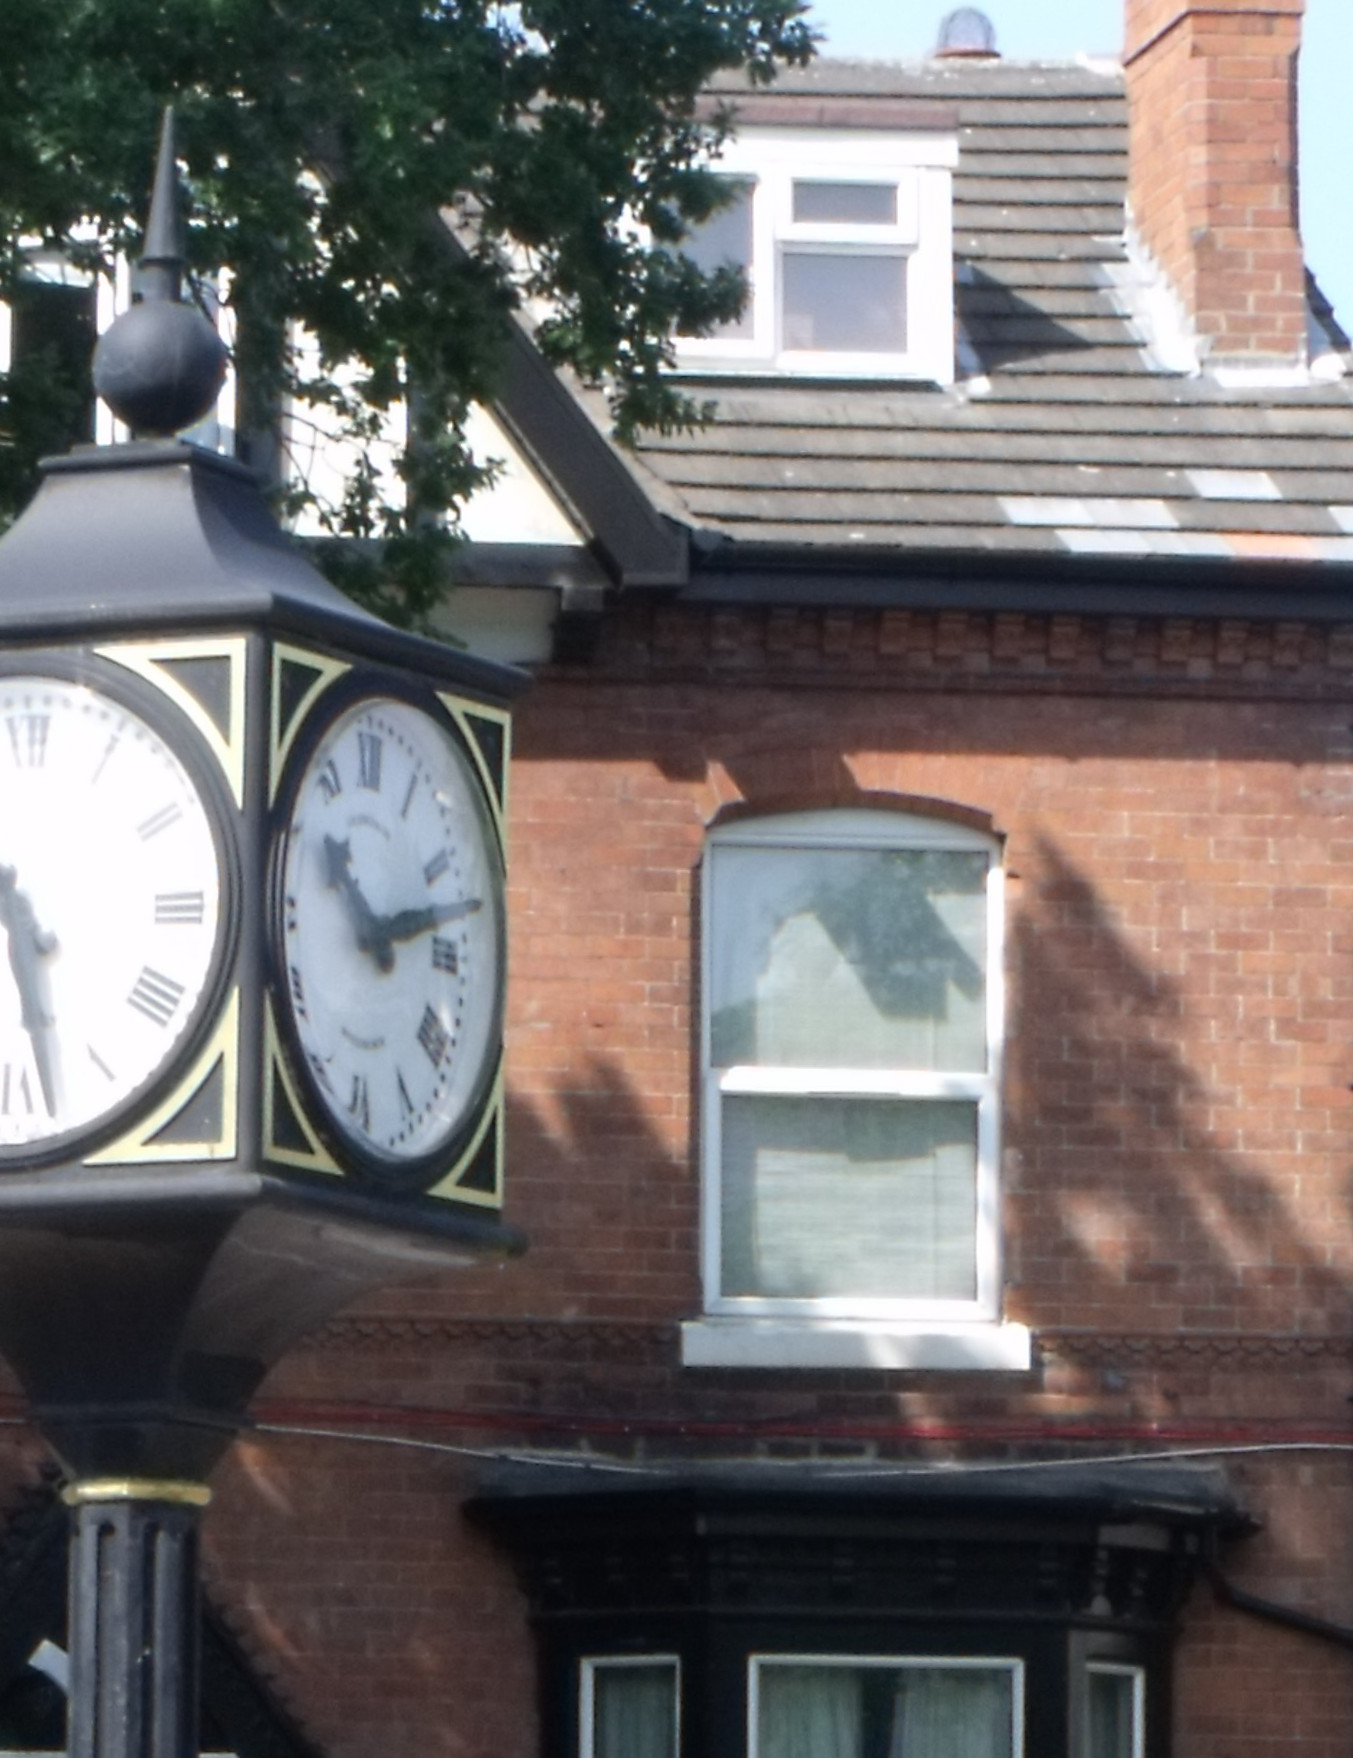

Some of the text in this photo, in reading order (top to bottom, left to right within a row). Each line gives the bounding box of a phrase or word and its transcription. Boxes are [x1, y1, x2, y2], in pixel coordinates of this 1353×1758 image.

[4, 713, 52, 769] XII
[135, 800, 184, 843] II
[154, 890, 205, 926] III
[125, 963, 187, 1030] IIII
